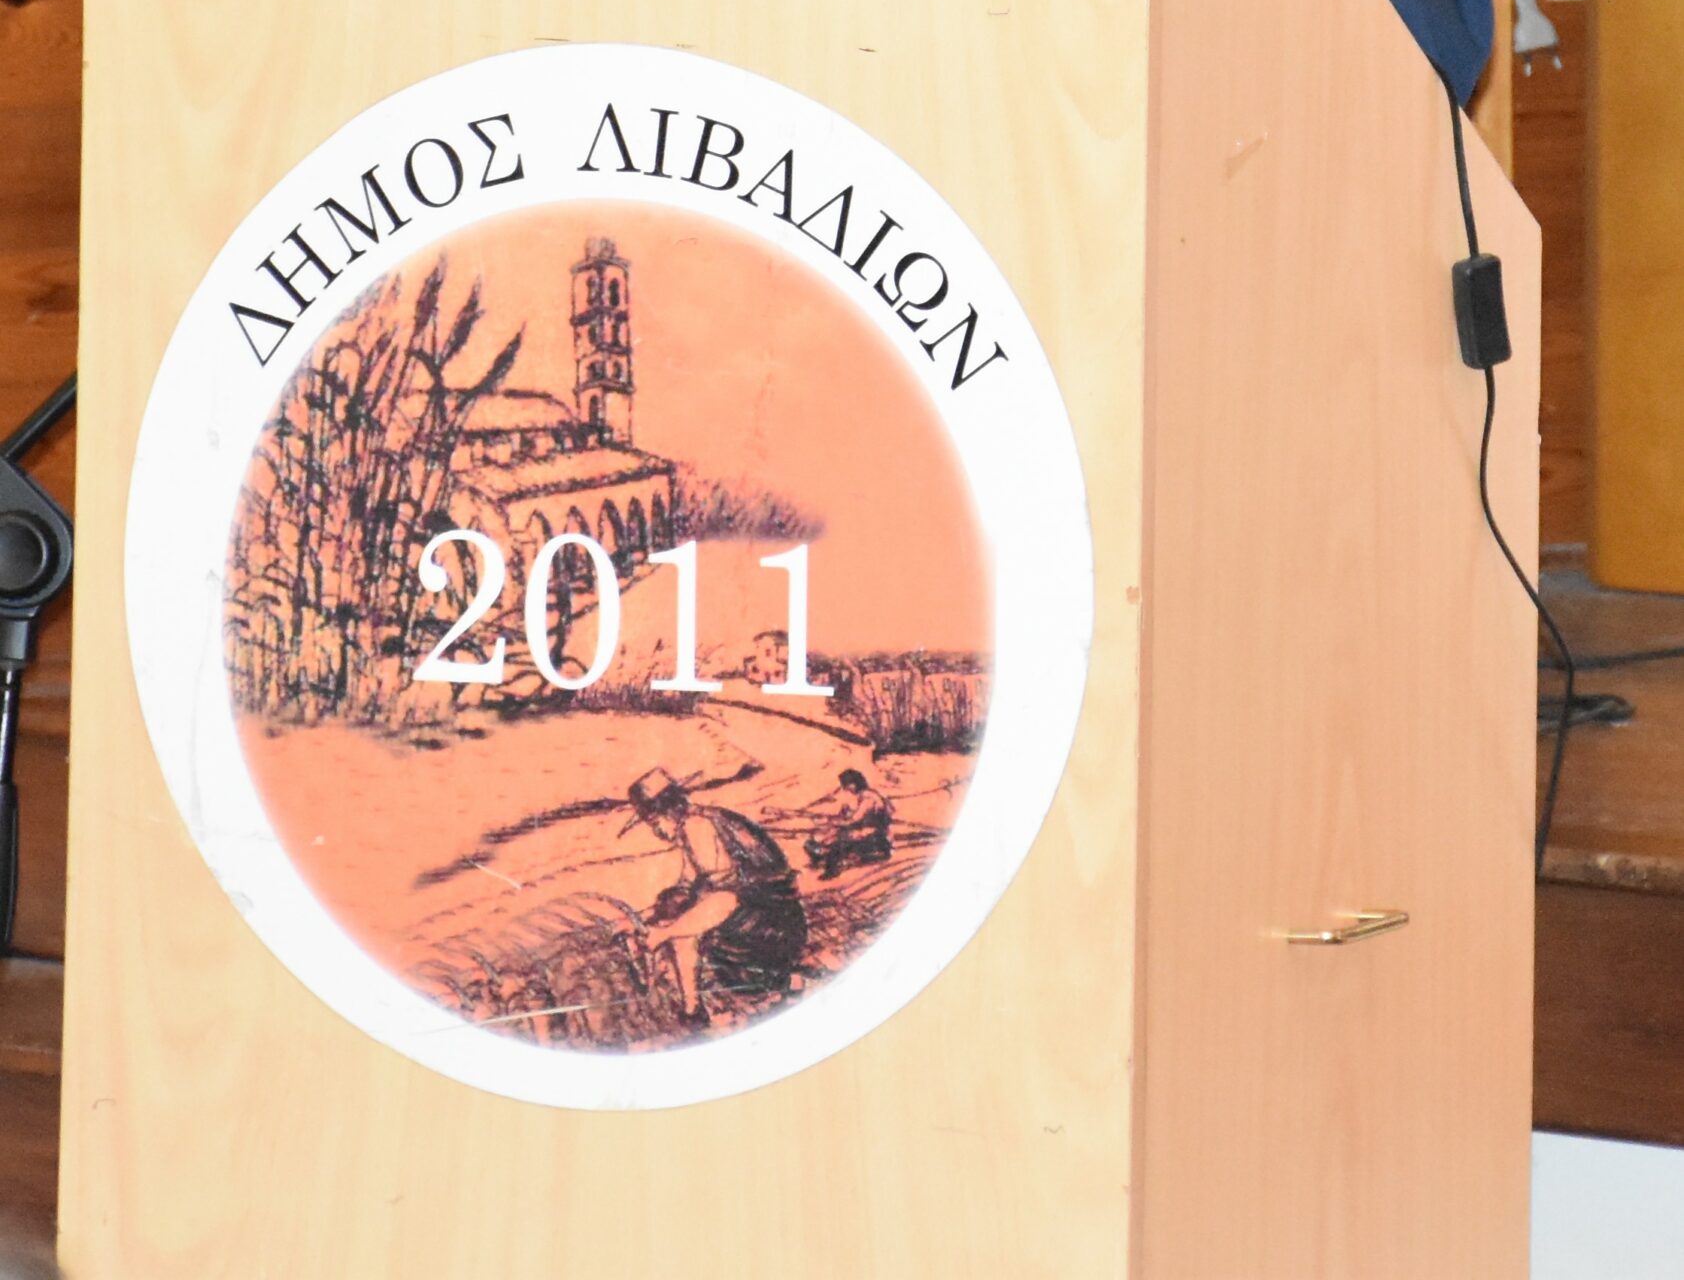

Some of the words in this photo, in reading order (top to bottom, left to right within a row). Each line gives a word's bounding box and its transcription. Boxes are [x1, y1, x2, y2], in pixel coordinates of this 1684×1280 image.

[229, 113, 525, 367] ΔΗΜΟΣ
[577, 103, 1008, 390] ΛΙΒΑΔΙΩΝ
[412, 529, 834, 696] 2011
